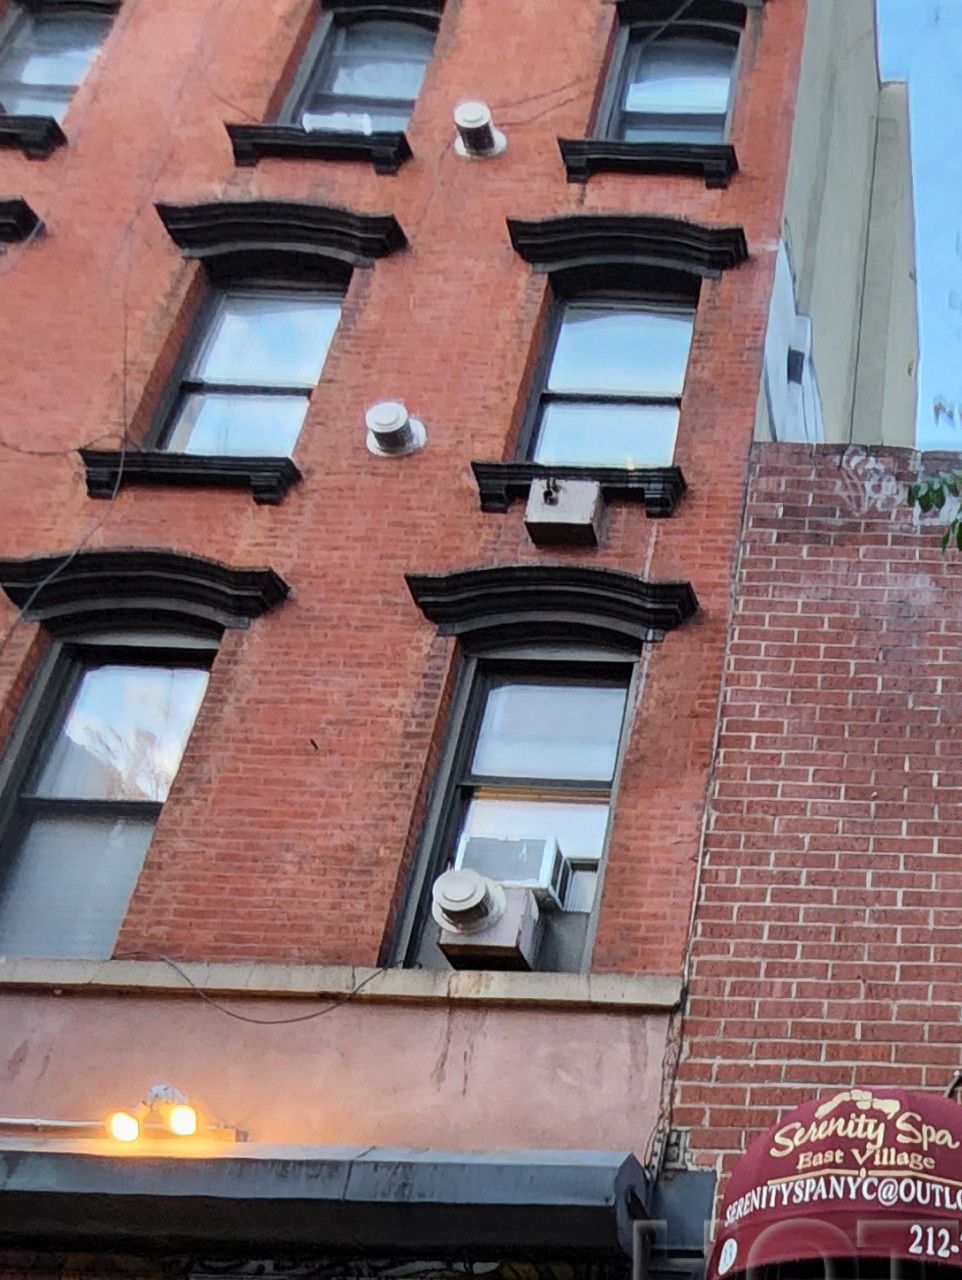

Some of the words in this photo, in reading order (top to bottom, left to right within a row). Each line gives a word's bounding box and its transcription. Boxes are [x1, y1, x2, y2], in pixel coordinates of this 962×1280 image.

[769, 1112, 885, 1157] Serenity
[896, 1112, 960, 1150] Spa
[796, 1149, 844, 1169] East
[851, 1147, 935, 1170] Village
